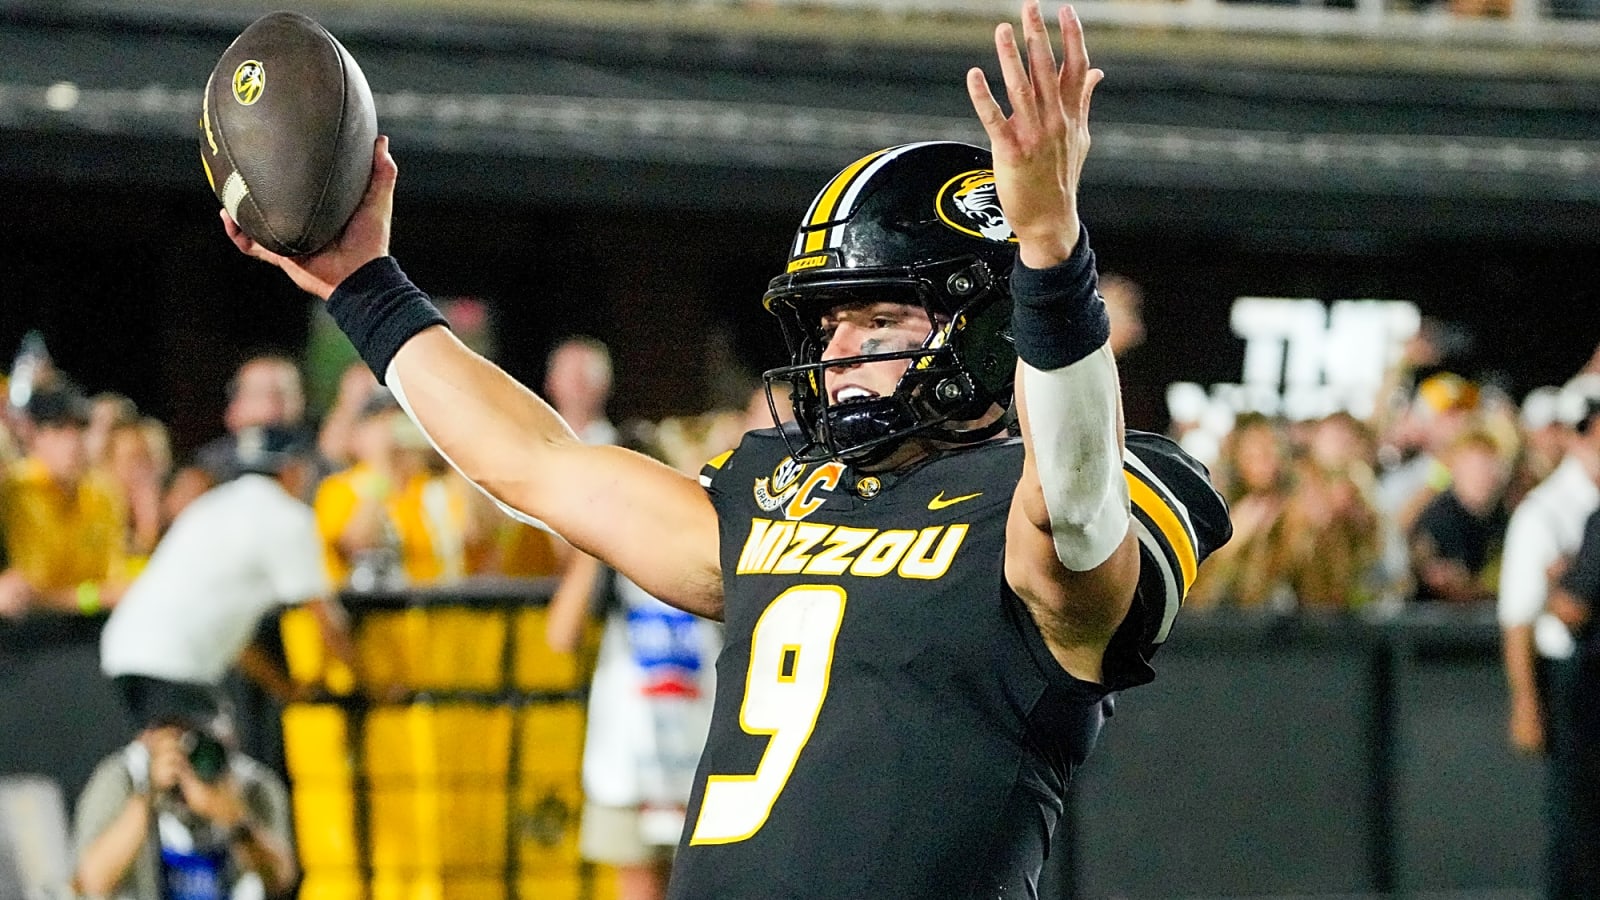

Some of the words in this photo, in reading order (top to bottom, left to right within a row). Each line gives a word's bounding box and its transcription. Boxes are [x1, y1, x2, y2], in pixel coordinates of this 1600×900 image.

[785, 461, 848, 521] C
[736, 517, 970, 581] MIZZOU
[689, 584, 848, 847] 9
